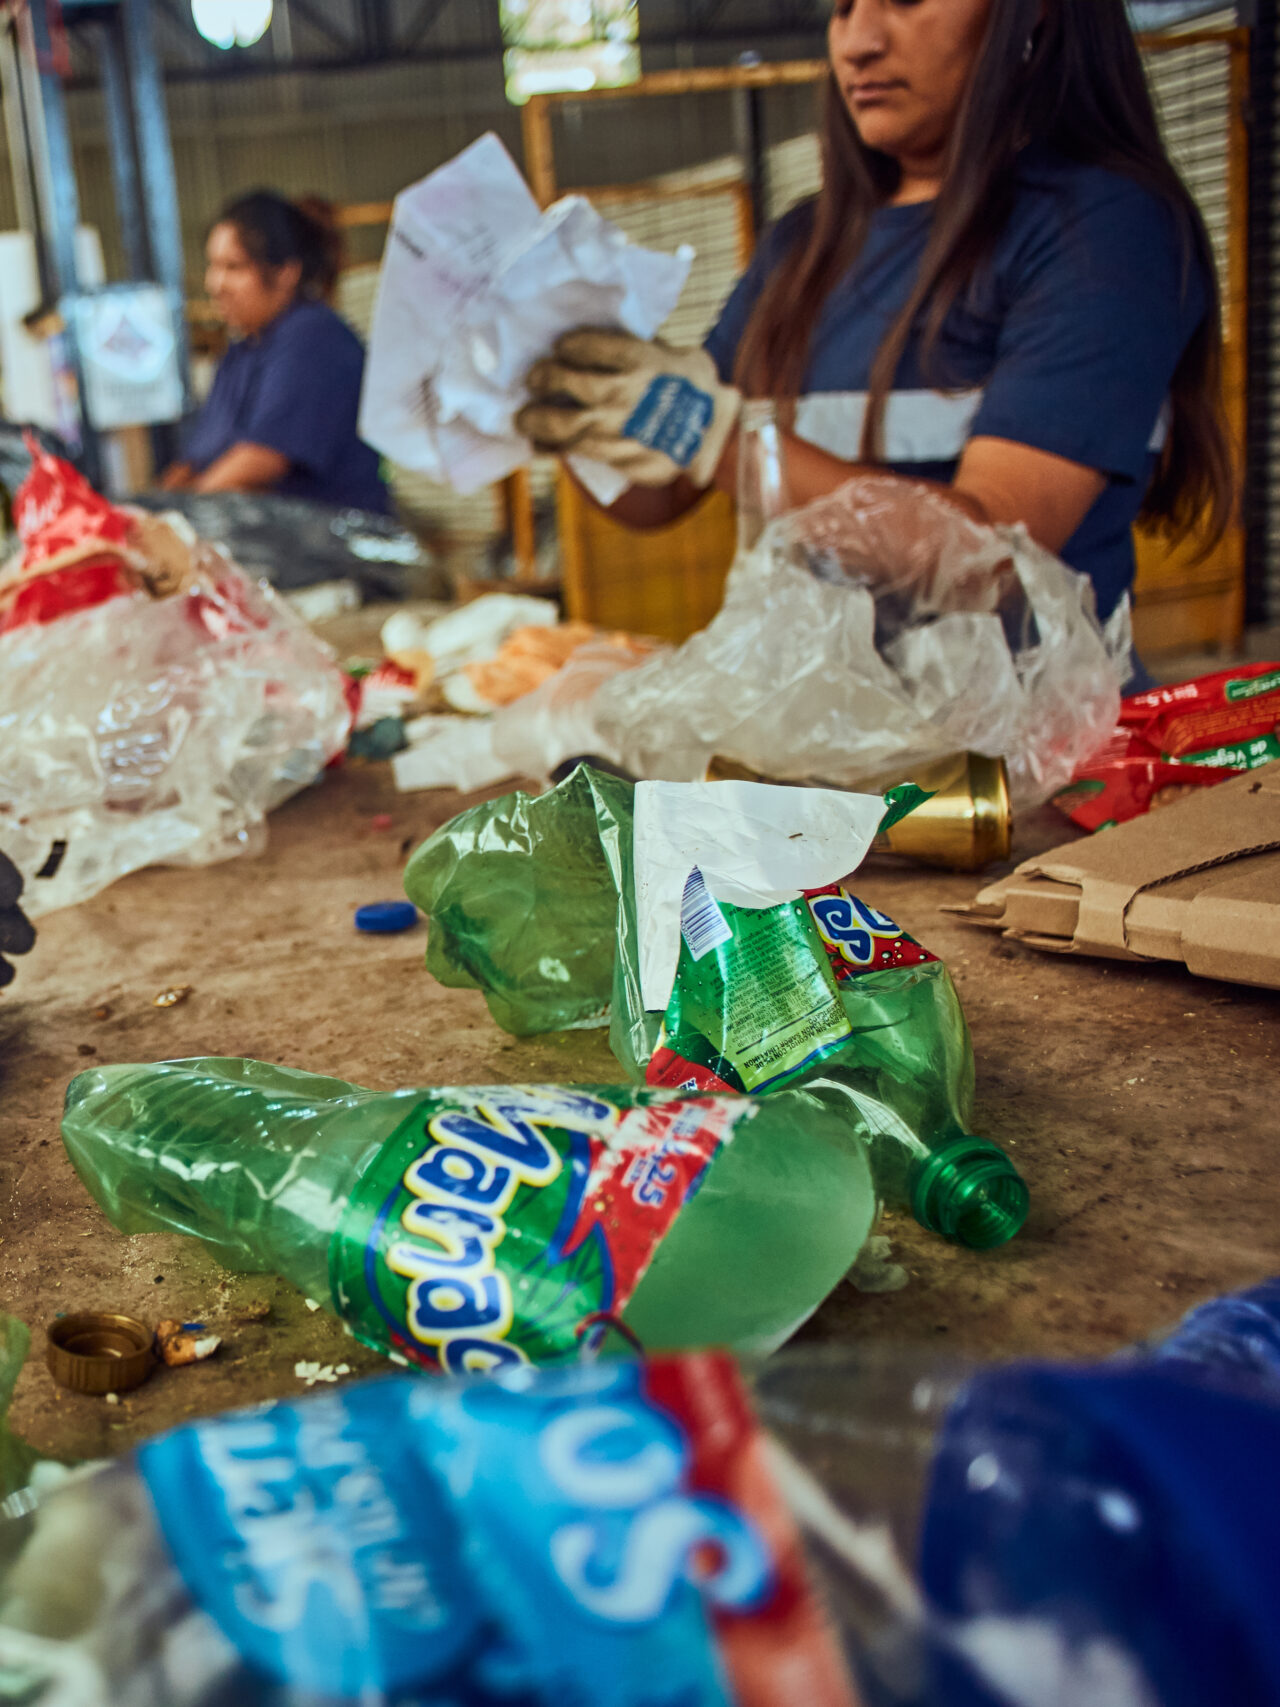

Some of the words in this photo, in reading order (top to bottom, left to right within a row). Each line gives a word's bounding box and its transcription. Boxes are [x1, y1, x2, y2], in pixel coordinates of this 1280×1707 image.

[787, 1031, 816, 1050] ALCOHOL
[773, 1047, 788, 1059] CON
[387, 1084, 620, 1376] Manao
